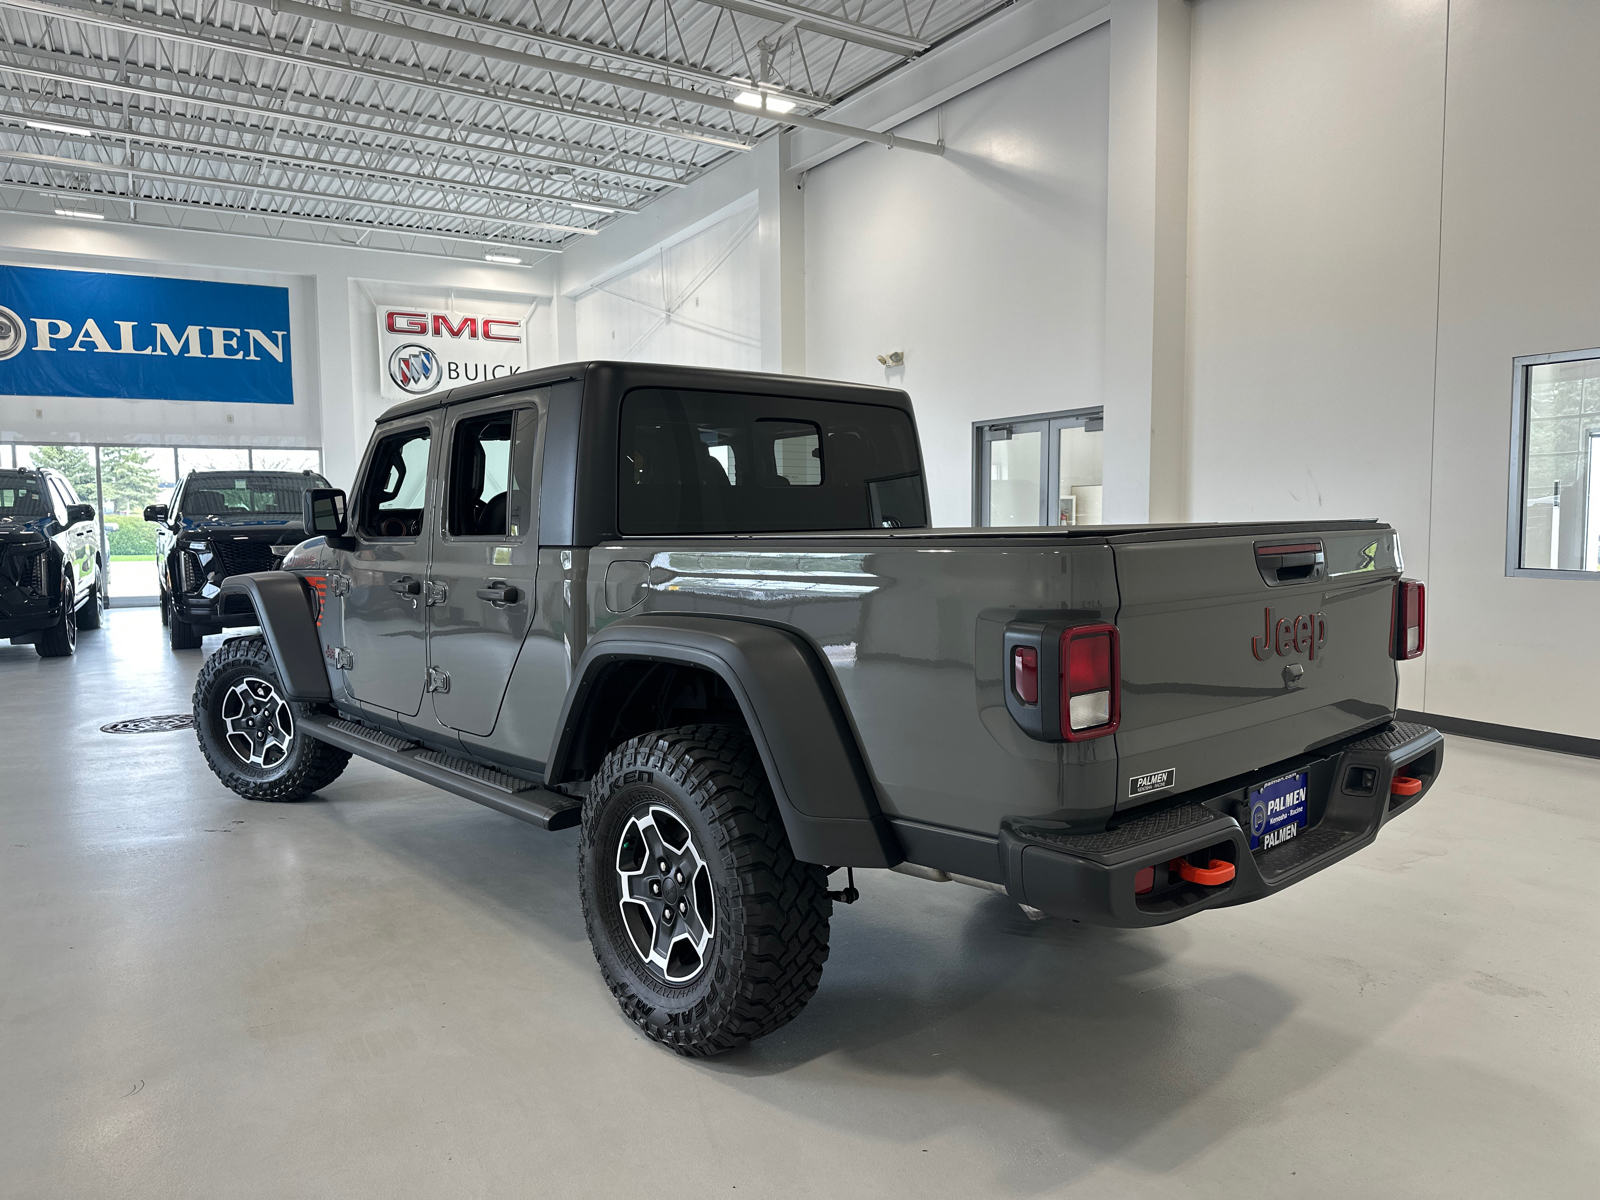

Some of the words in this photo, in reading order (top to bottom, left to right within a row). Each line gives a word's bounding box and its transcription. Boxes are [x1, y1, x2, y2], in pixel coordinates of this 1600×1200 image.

[29, 318, 288, 363] PALMEN
[385, 309, 522, 344] GMC
[1251, 606, 1329, 661] Jeep
[325, 644, 336, 660] Jee
[1137, 772, 1168, 788] PALMEN
[1263, 772, 1297, 789] palmen.com
[1267, 787, 1306, 816] PALMEN
[1270, 812, 1288, 825] Kenosha
[1289, 806, 1304, 817] Racine
[1263, 822, 1298, 850] PALMEN
